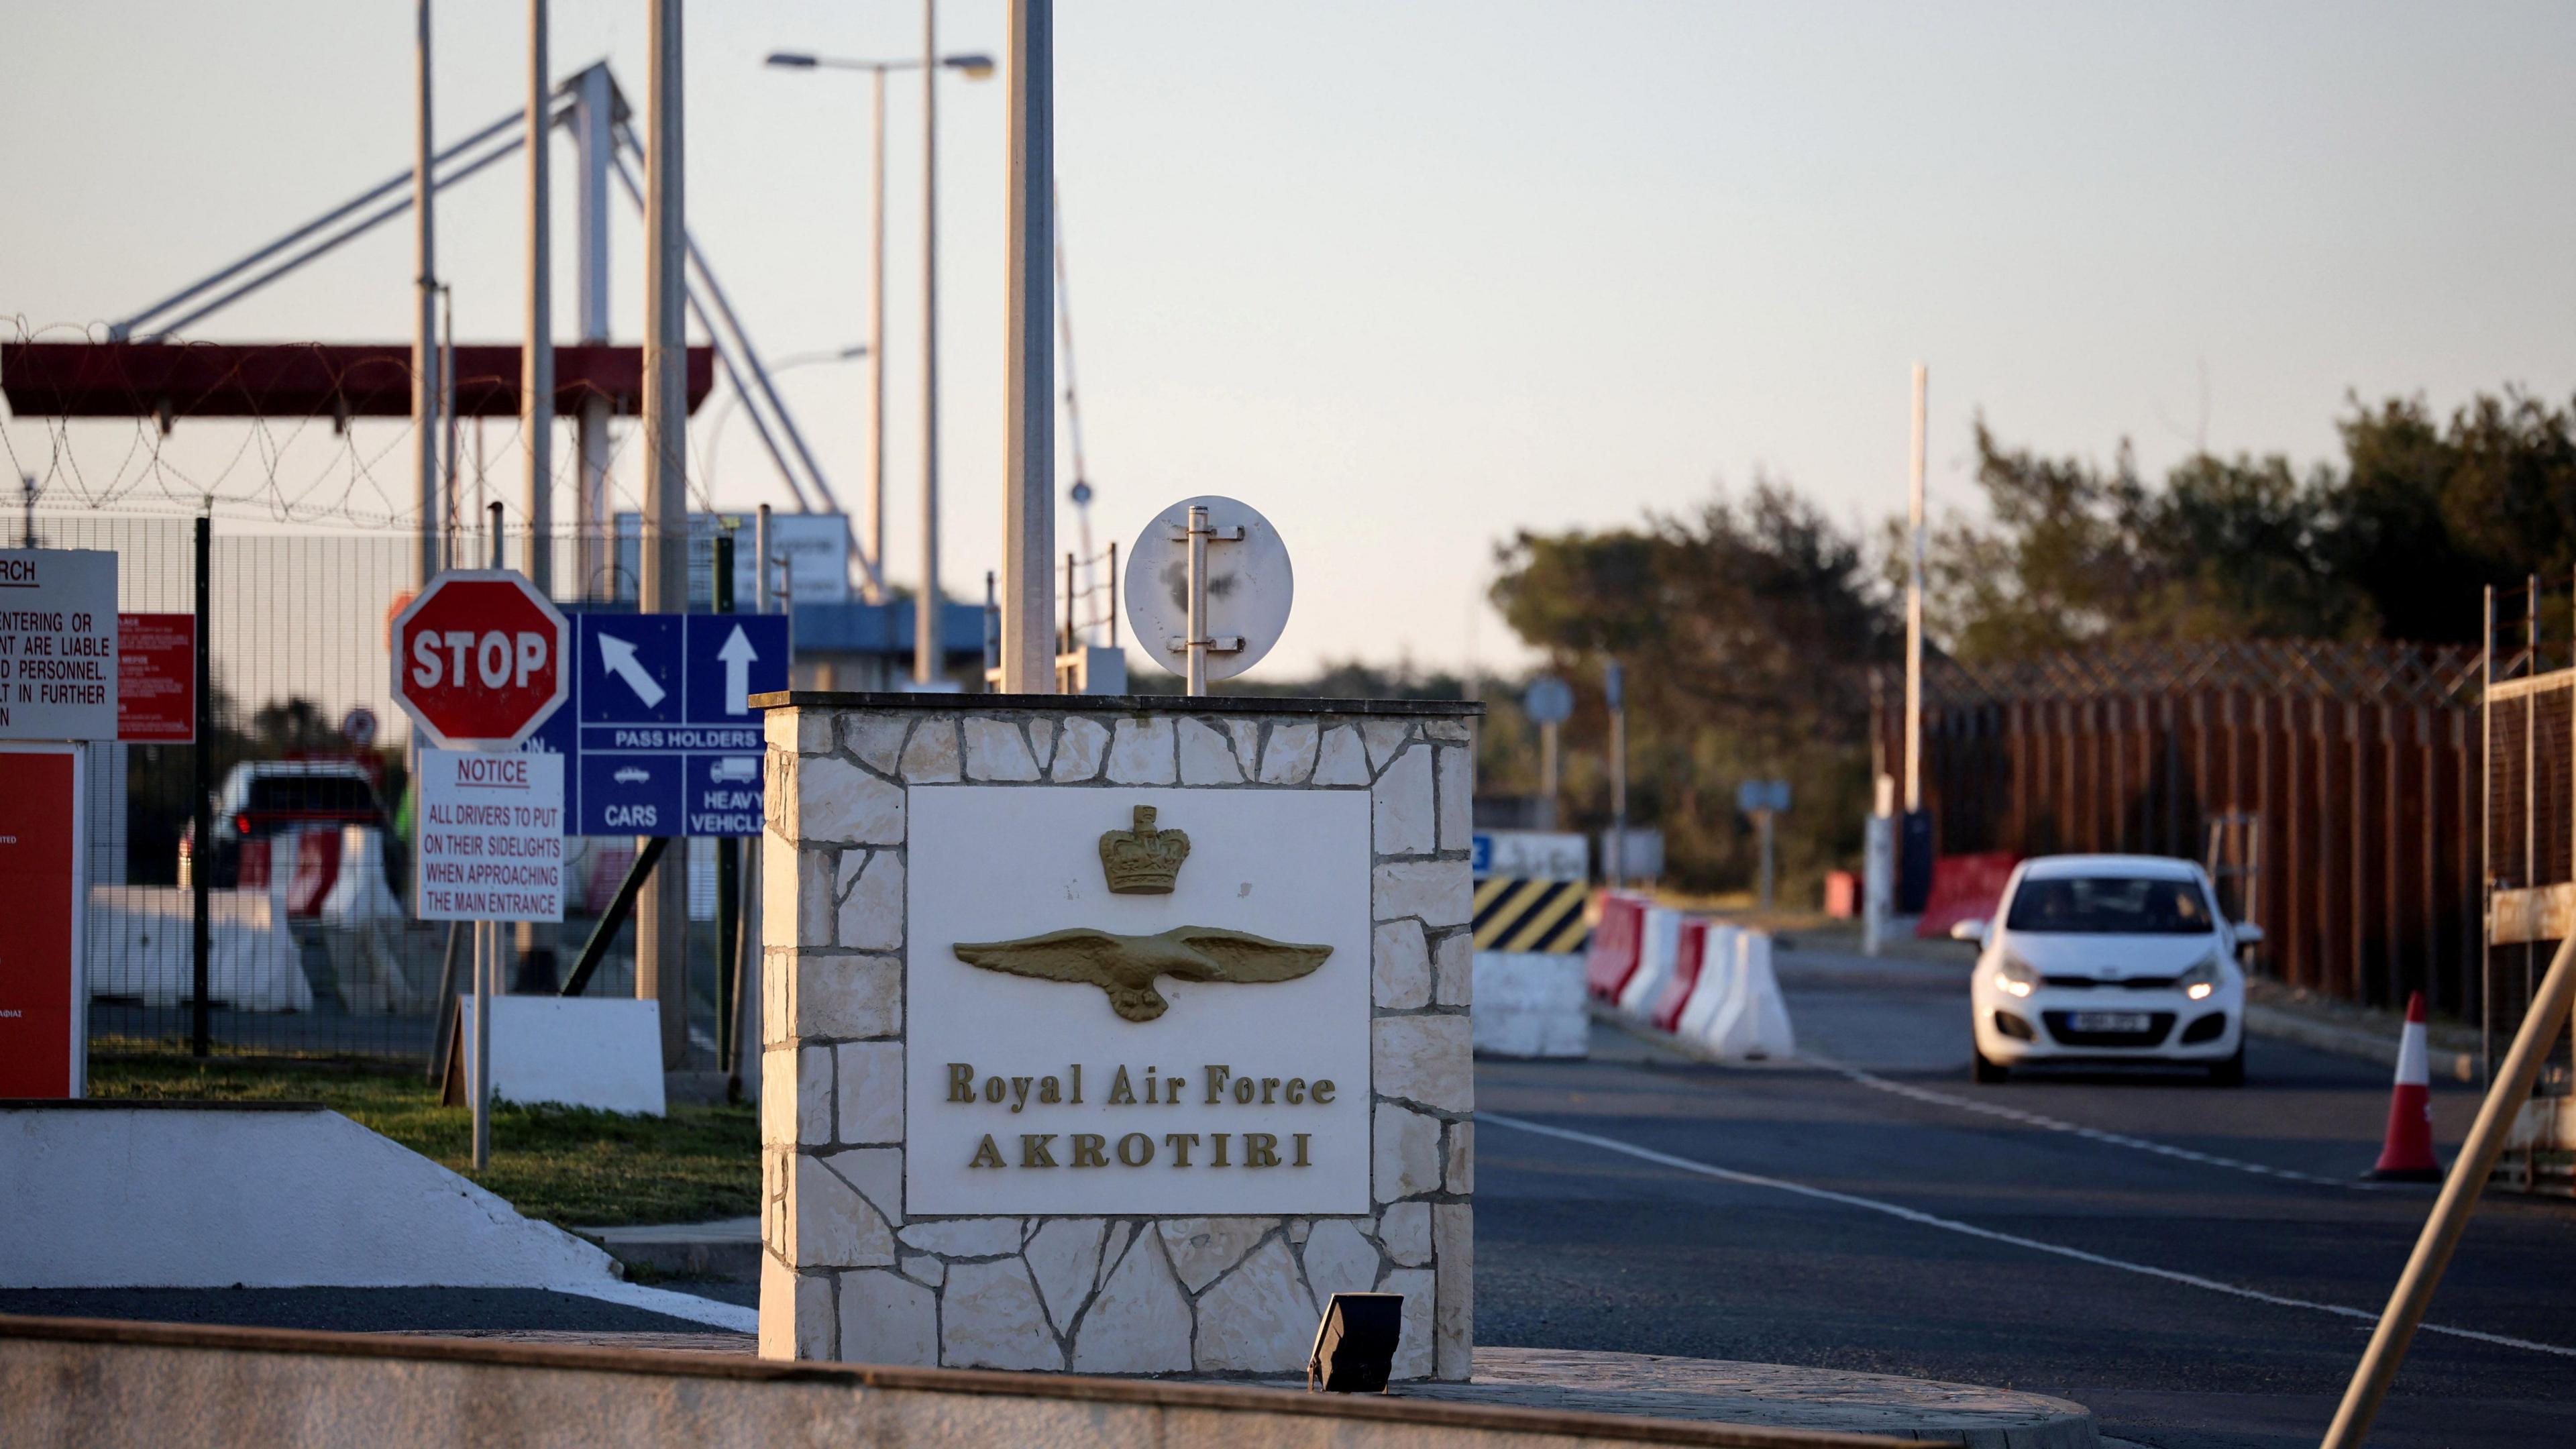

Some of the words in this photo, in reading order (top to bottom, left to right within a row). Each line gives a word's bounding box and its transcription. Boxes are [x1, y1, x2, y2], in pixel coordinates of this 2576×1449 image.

[0, 612, 62, 633] NTERING
[72, 612, 92, 633] OR
[24, 637, 52, 655] ARE
[62, 637, 109, 657] LIABLE
[19, 660, 106, 680] PERSONNEL.
[412, 630, 547, 689] STOP
[19, 684, 32, 703] IN
[42, 684, 105, 704] FURTHER
[615, 731, 664, 747] PASS
[668, 731, 757, 747] HOLDERS
[458, 759, 527, 784] NOTICE
[704, 790, 763, 810] HEAVY
[429, 804, 453, 824] ALL
[456, 805, 511, 826] DRIVERS
[515, 807, 531, 827] TO
[534, 808, 558, 828] PUT
[604, 804, 657, 826] CARS
[425, 835, 443, 855] ON
[446, 835, 483, 856] THEIR
[488, 836, 560, 858] SIDELIGHTS
[426, 863, 464, 883] WHEN
[467, 865, 558, 886] APPROACHING
[427, 891, 451, 912] THE
[455, 893, 486, 912] MAIN
[489, 894, 555, 914] ENTRANCE
[947, 1063, 1084, 1114] Royal
[1108, 1064, 1185, 1104] Air
[1205, 1065, 1336, 1105] Force
[969, 1132, 1313, 1169] AKROTIRI
